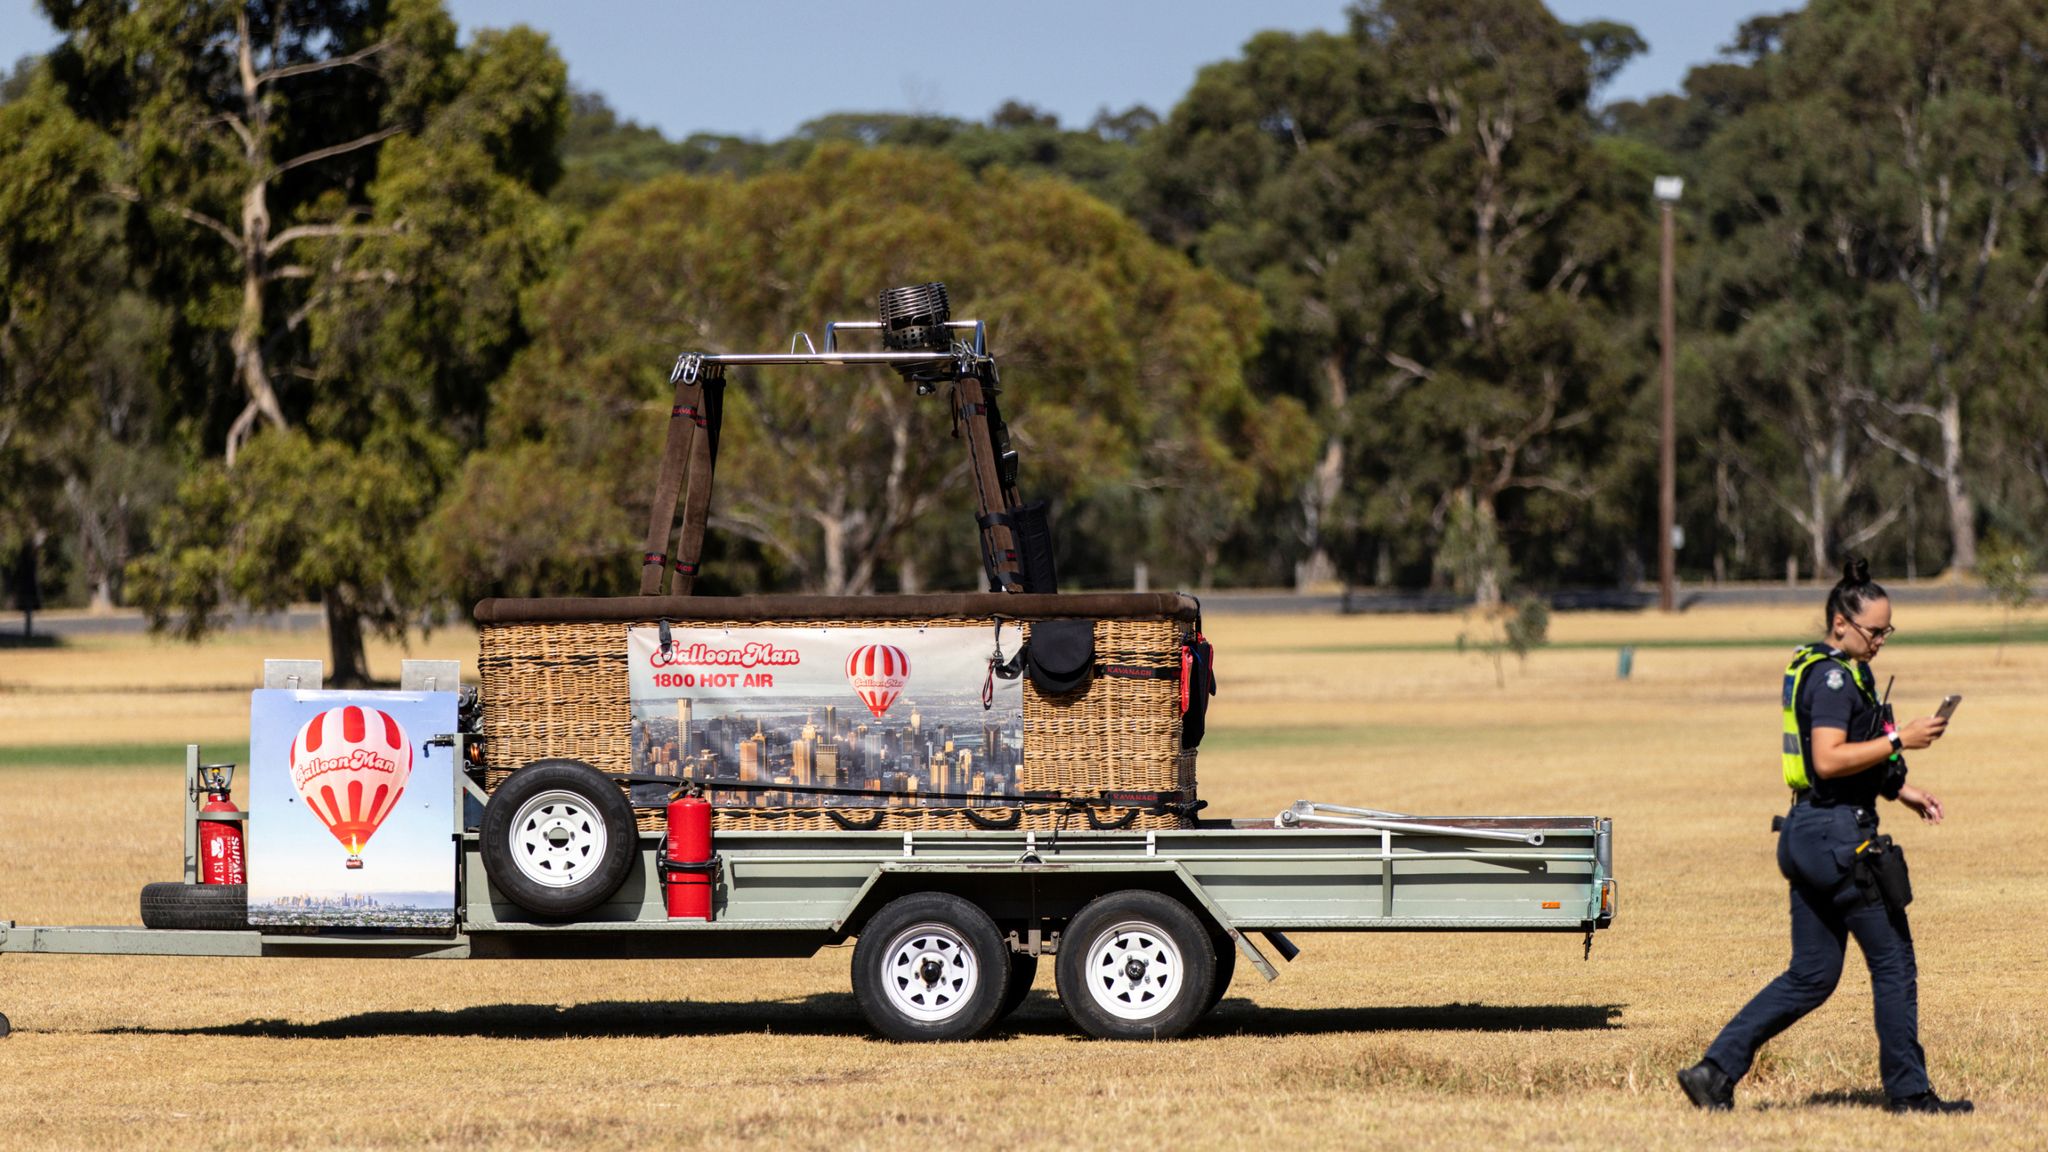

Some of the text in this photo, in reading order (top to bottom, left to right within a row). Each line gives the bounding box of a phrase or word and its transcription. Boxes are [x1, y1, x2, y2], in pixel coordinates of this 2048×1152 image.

[652, 674, 773, 687] 1800 HOT AIR
